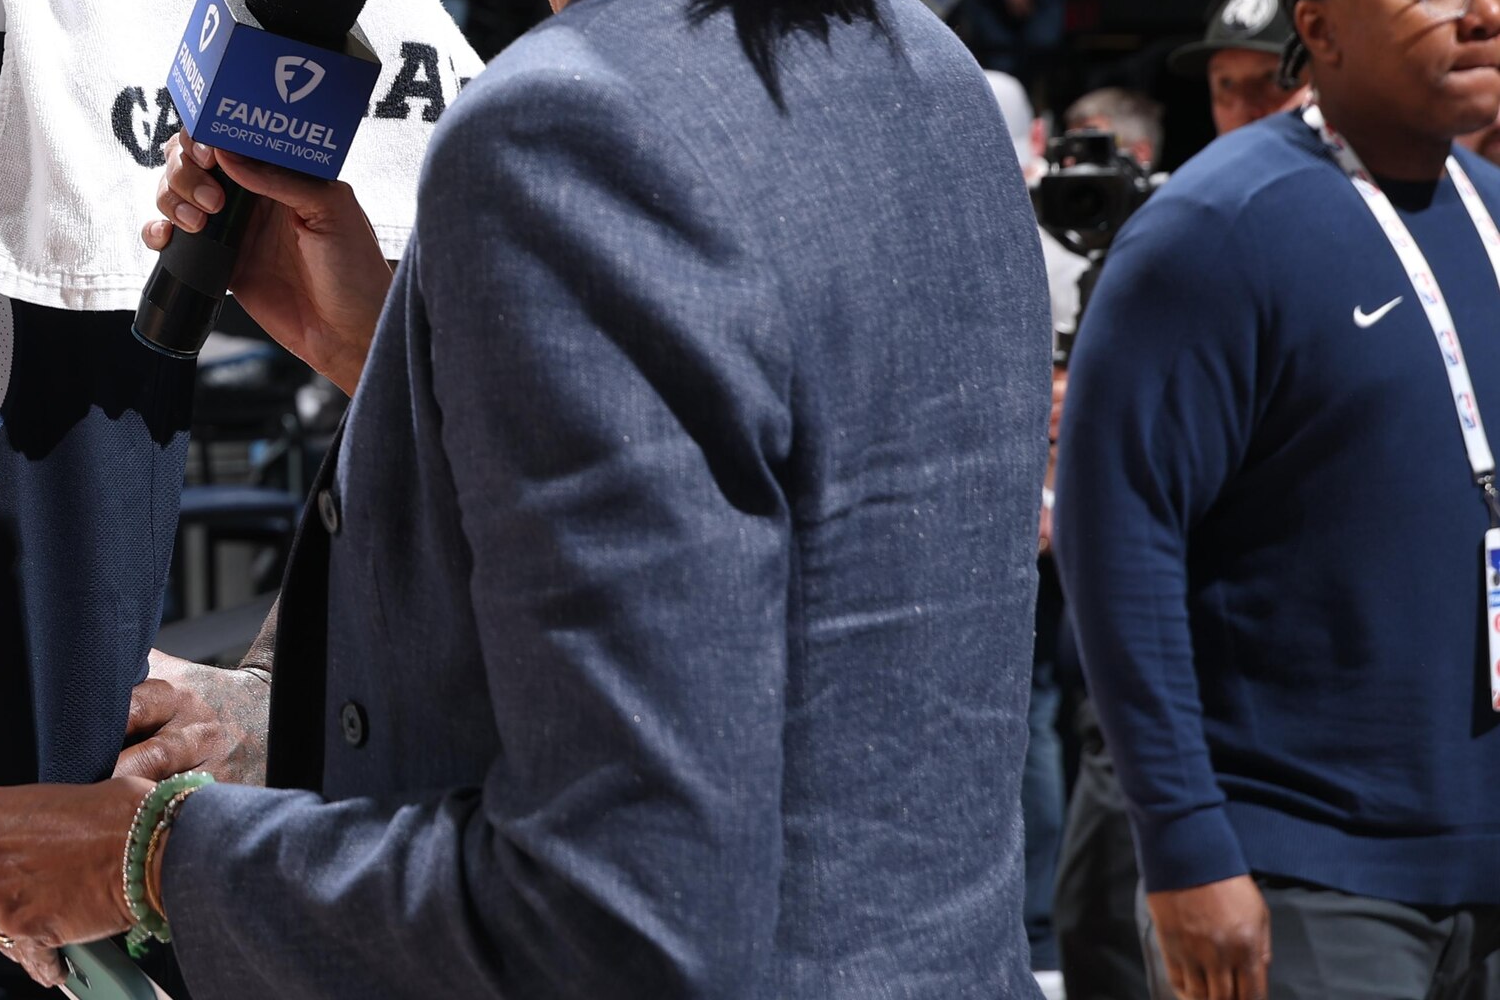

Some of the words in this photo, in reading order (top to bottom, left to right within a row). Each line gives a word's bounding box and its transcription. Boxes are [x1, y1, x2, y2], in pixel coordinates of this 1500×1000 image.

[178, 41, 205, 105] FANDUEL
[210, 121, 264, 145] SPORTS
[264, 137, 333, 166] NETWORK
[216, 97, 337, 150] FANDUEL
